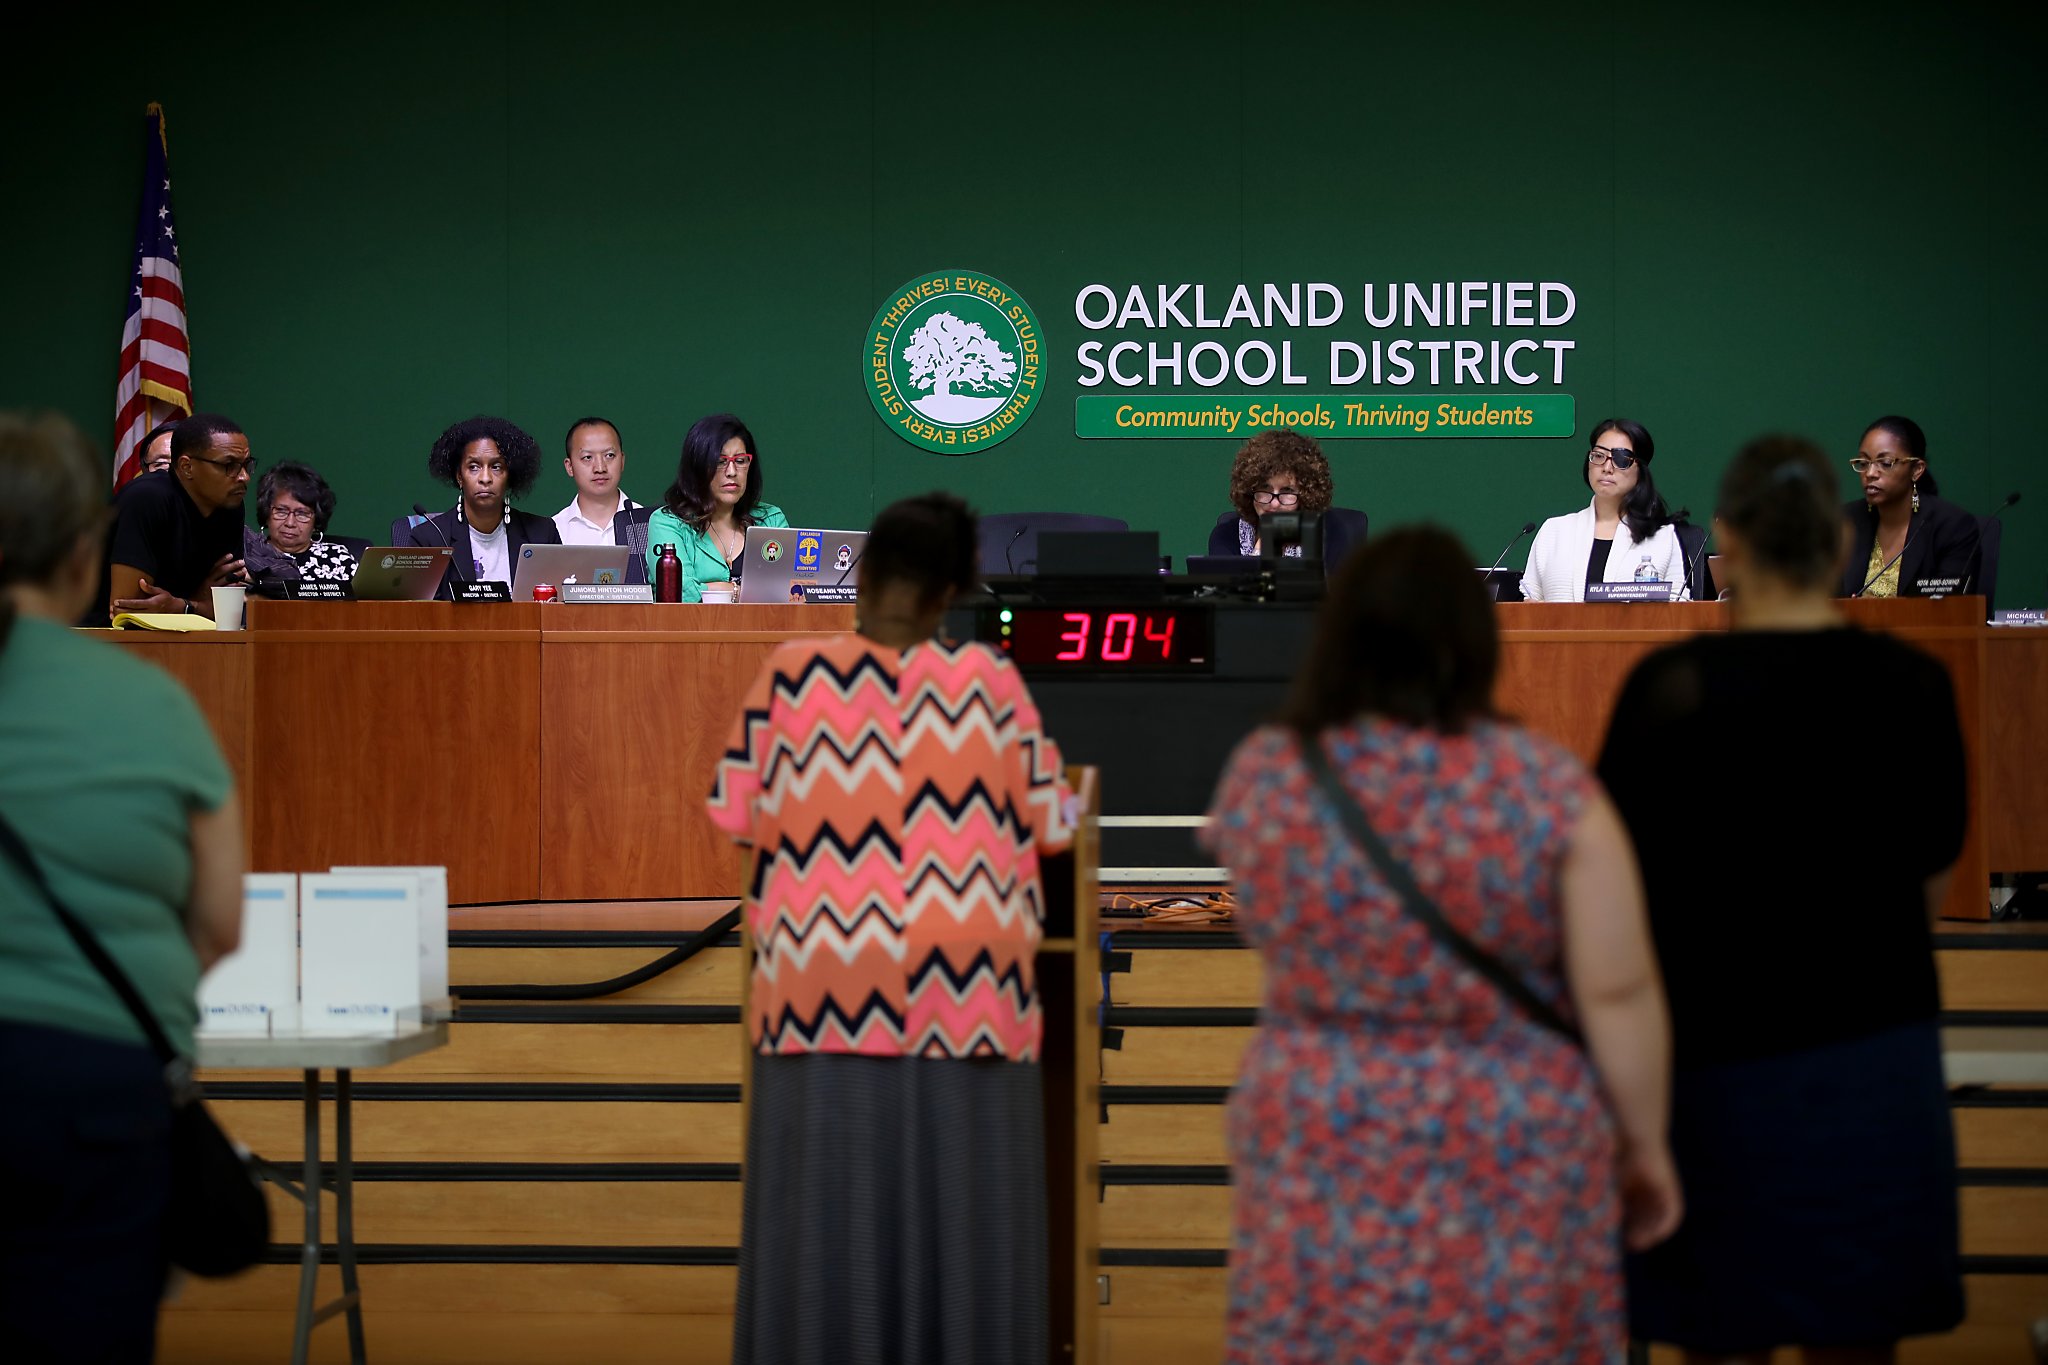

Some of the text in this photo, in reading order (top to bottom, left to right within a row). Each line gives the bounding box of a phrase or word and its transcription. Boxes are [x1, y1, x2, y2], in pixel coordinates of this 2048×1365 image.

[1075, 281, 1577, 330] OAKLAND UNIFIED
[872, 277, 957, 445] EVERY STUDENT THRIVES!
[954, 277, 1039, 444] EVERY STUDENT THRIVES!
[1077, 339, 1576, 387] SCHOOL DISTRICT
[1115, 403, 1534, 433] Community Schools, Thriving Students
[299, 583, 340, 591] JAMES HARRIS
[468, 584, 493, 592] GARY YEE
[1056, 613, 1175, 661] 304
